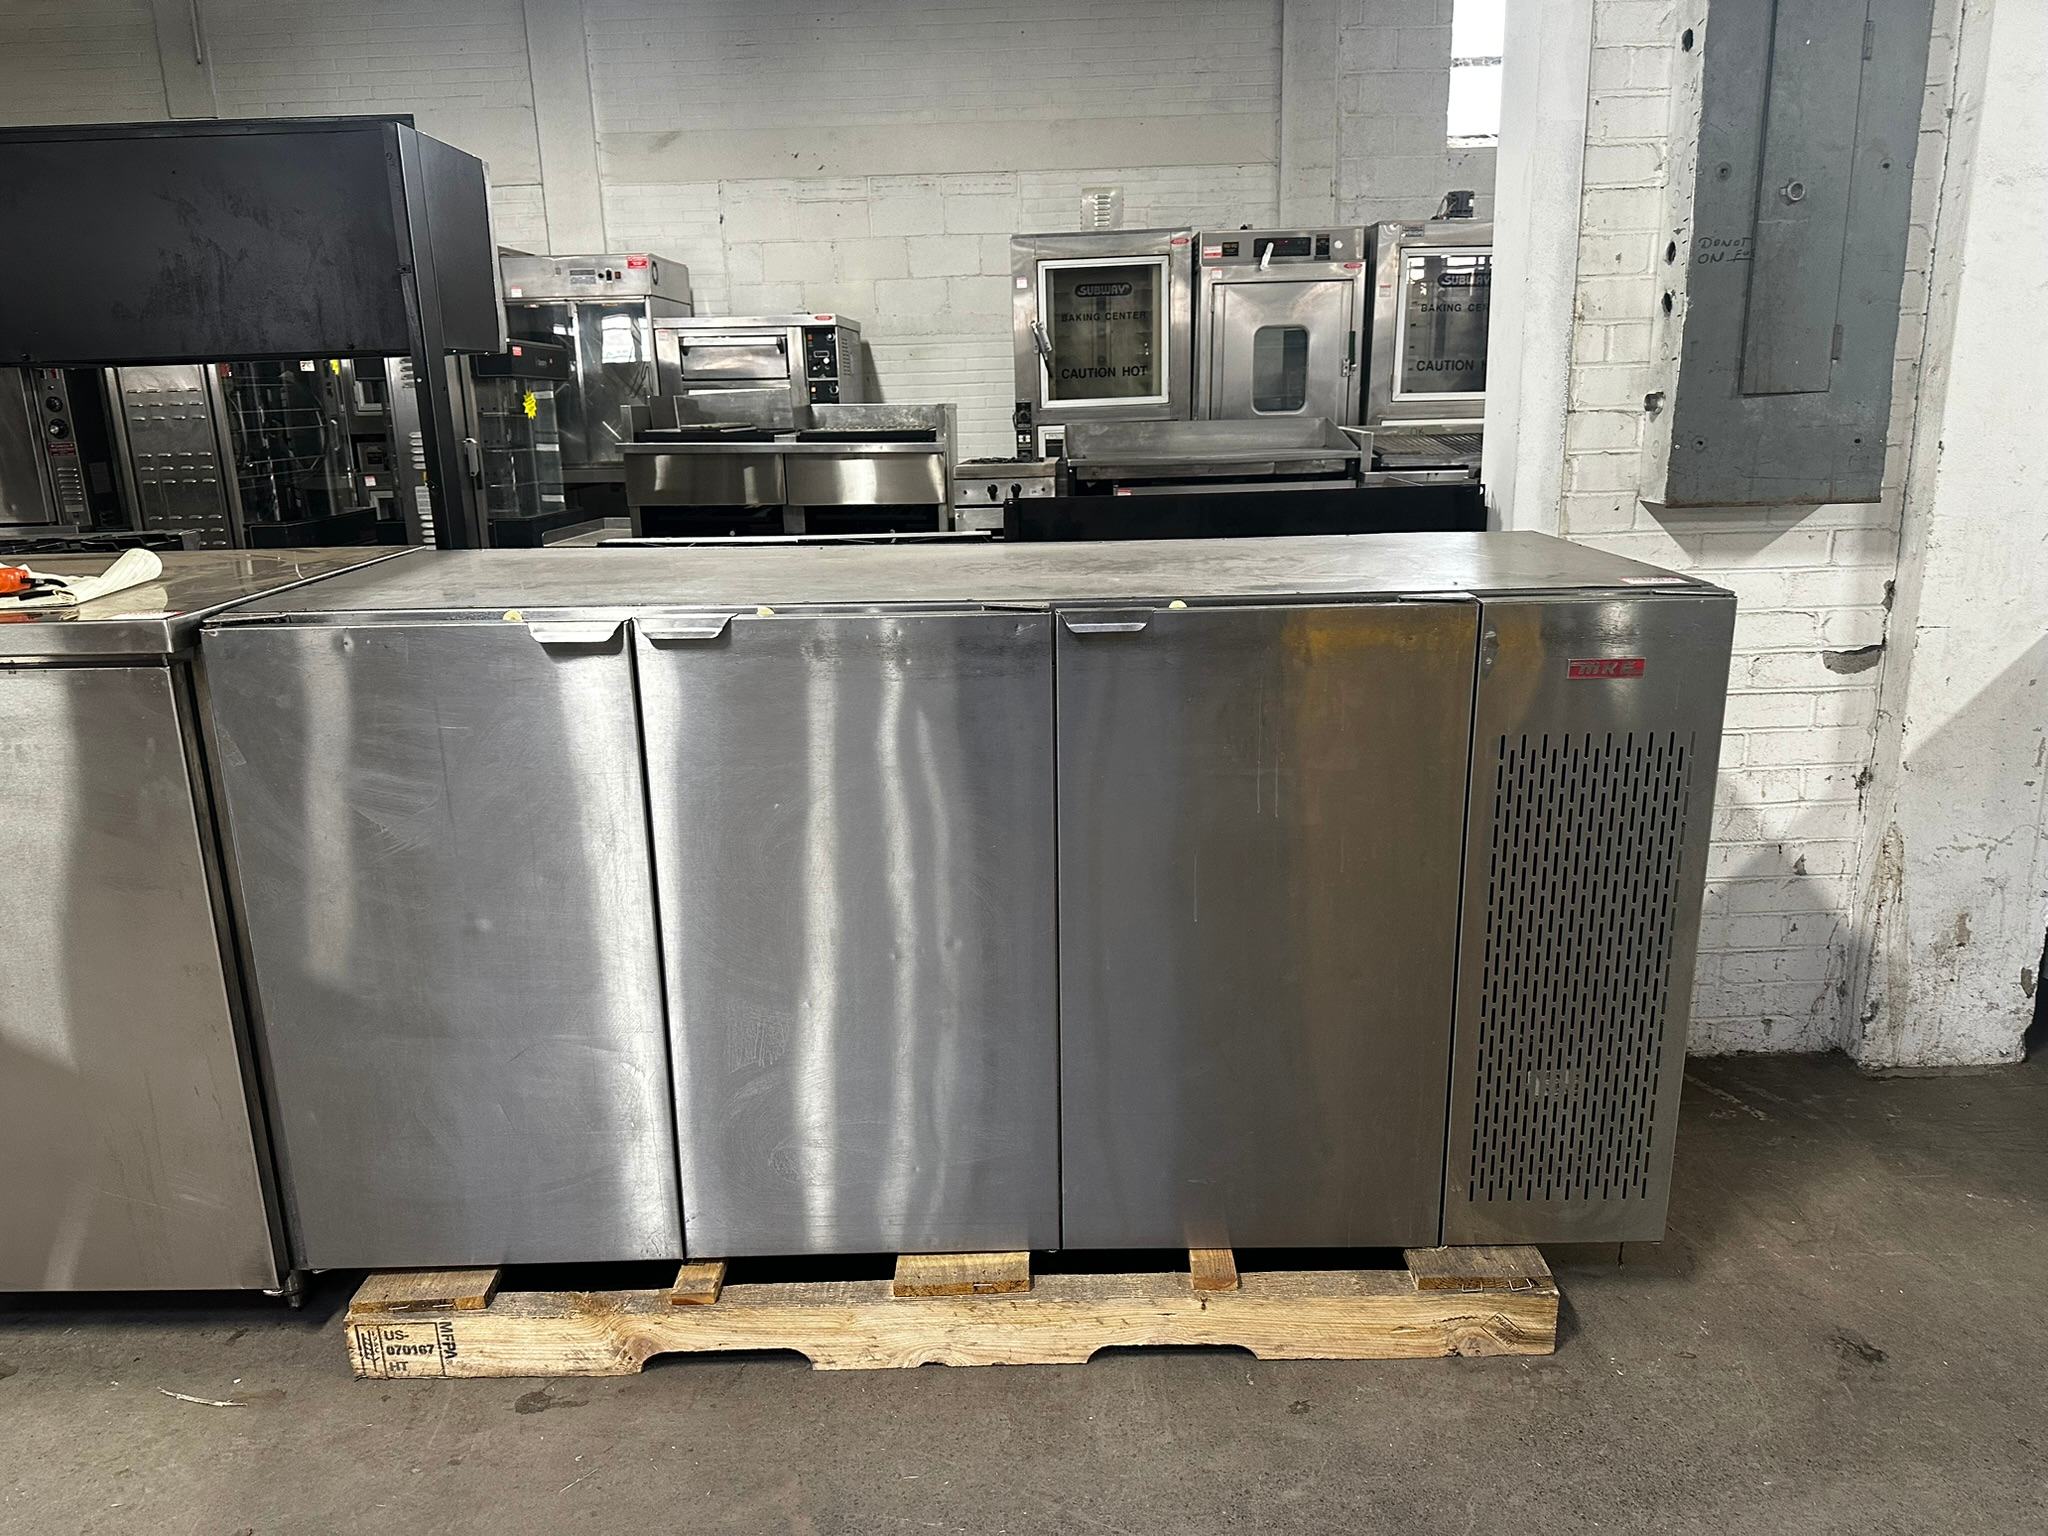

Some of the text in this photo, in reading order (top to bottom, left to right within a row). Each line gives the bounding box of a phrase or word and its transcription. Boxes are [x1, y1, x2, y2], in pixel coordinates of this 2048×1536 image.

[1698, 252, 1724, 264] ON
[1077, 283, 1128, 296] SUBWAY
[1421, 303, 1462, 313] BAKING
[1061, 311, 1147, 322] BAKING CENTER
[1416, 360, 1474, 372] CAUTION
[1061, 365, 1148, 379] CAUTION HOT
[384, 1330, 409, 1340] US-
[389, 1361, 408, 1371] HT
